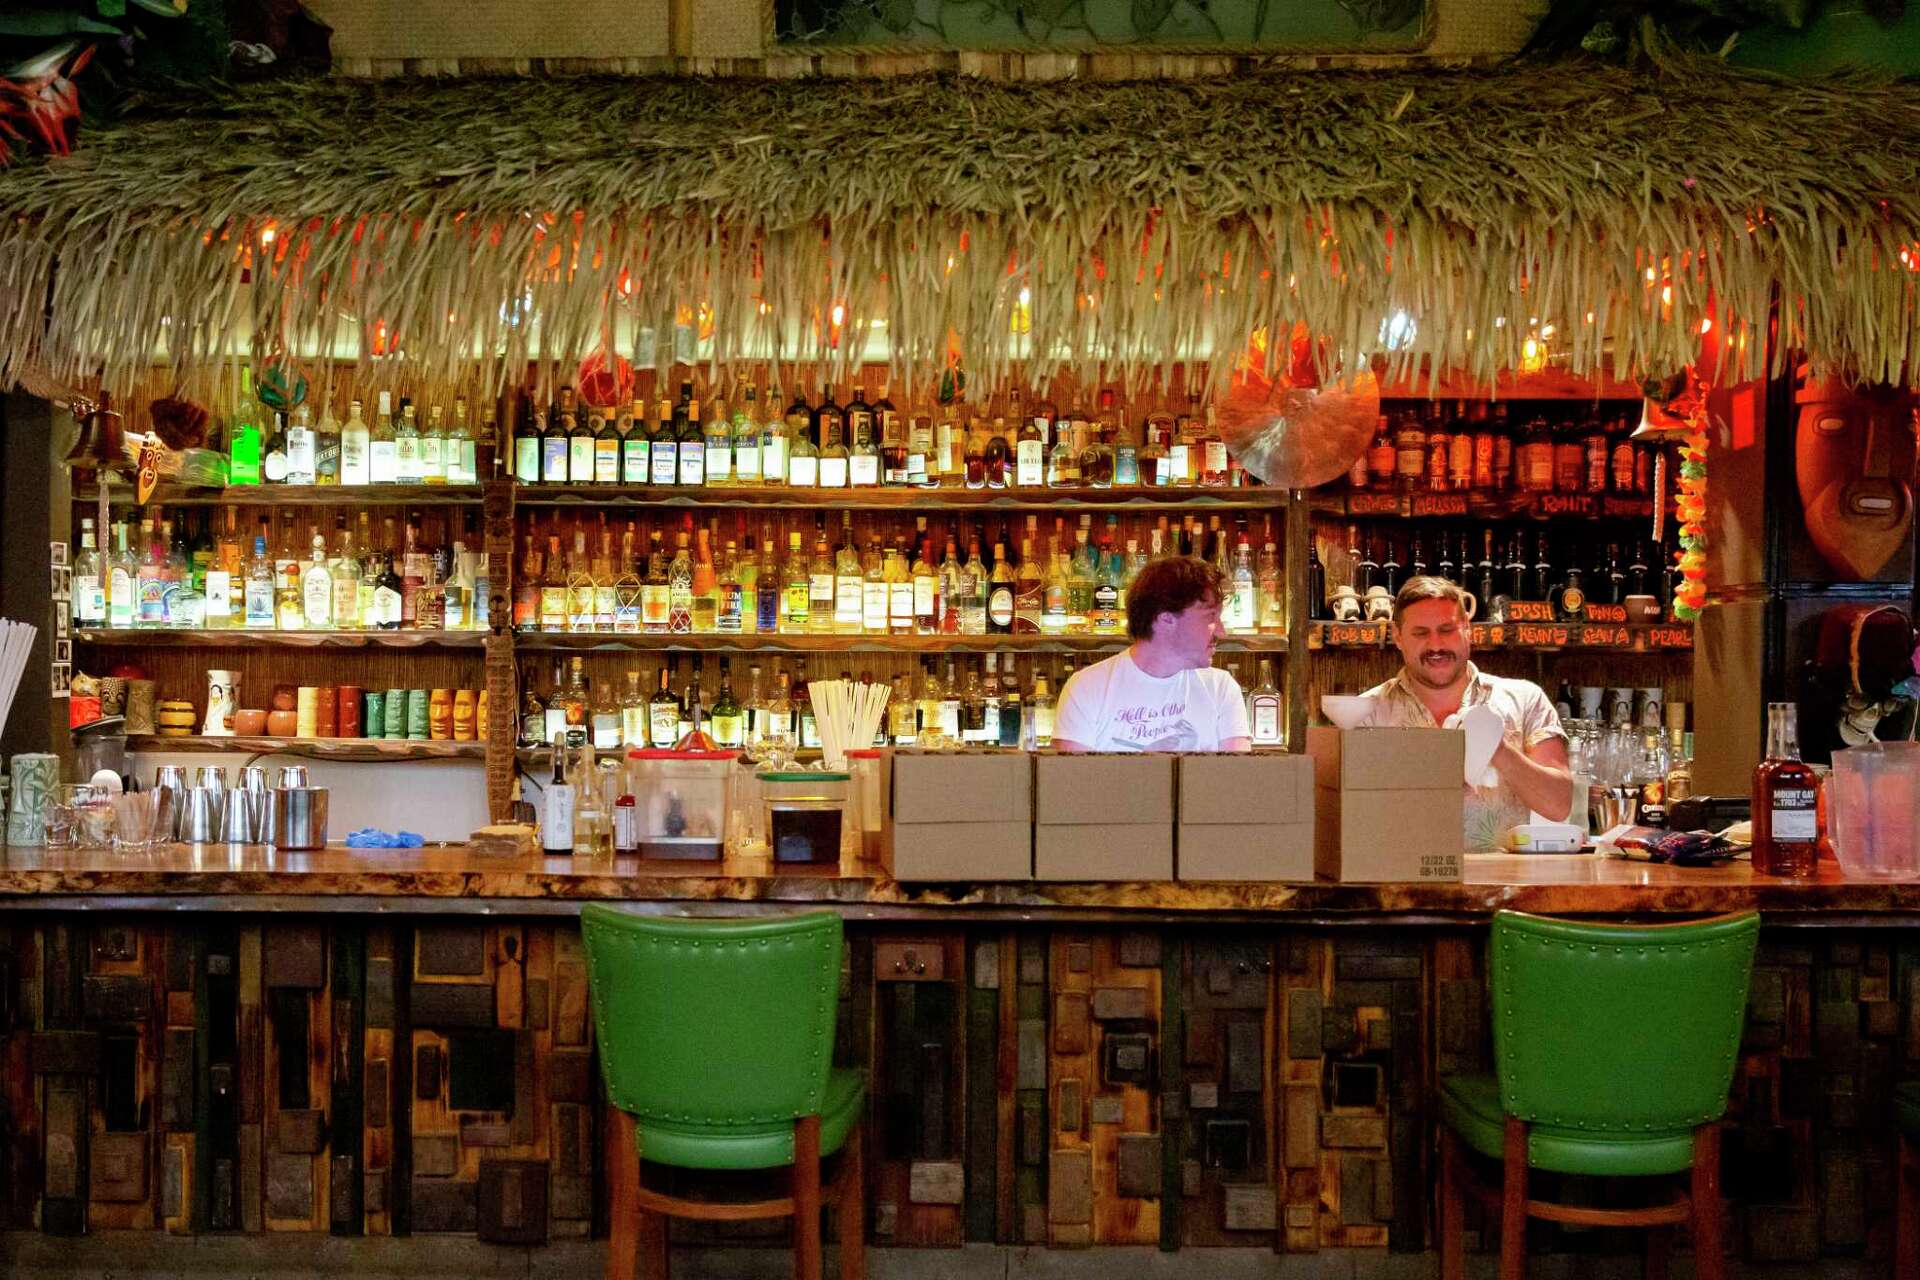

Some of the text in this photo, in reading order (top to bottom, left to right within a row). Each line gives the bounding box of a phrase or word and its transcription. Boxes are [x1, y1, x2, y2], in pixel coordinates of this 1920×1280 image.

[1509, 603, 1553, 621] JOSH
[1583, 627, 1614, 645] SEAN
[1650, 629, 1692, 646] PEARL
[1115, 703, 1186, 724] Hell is Othe
[1773, 789, 1815, 799] MOUNT GAY
